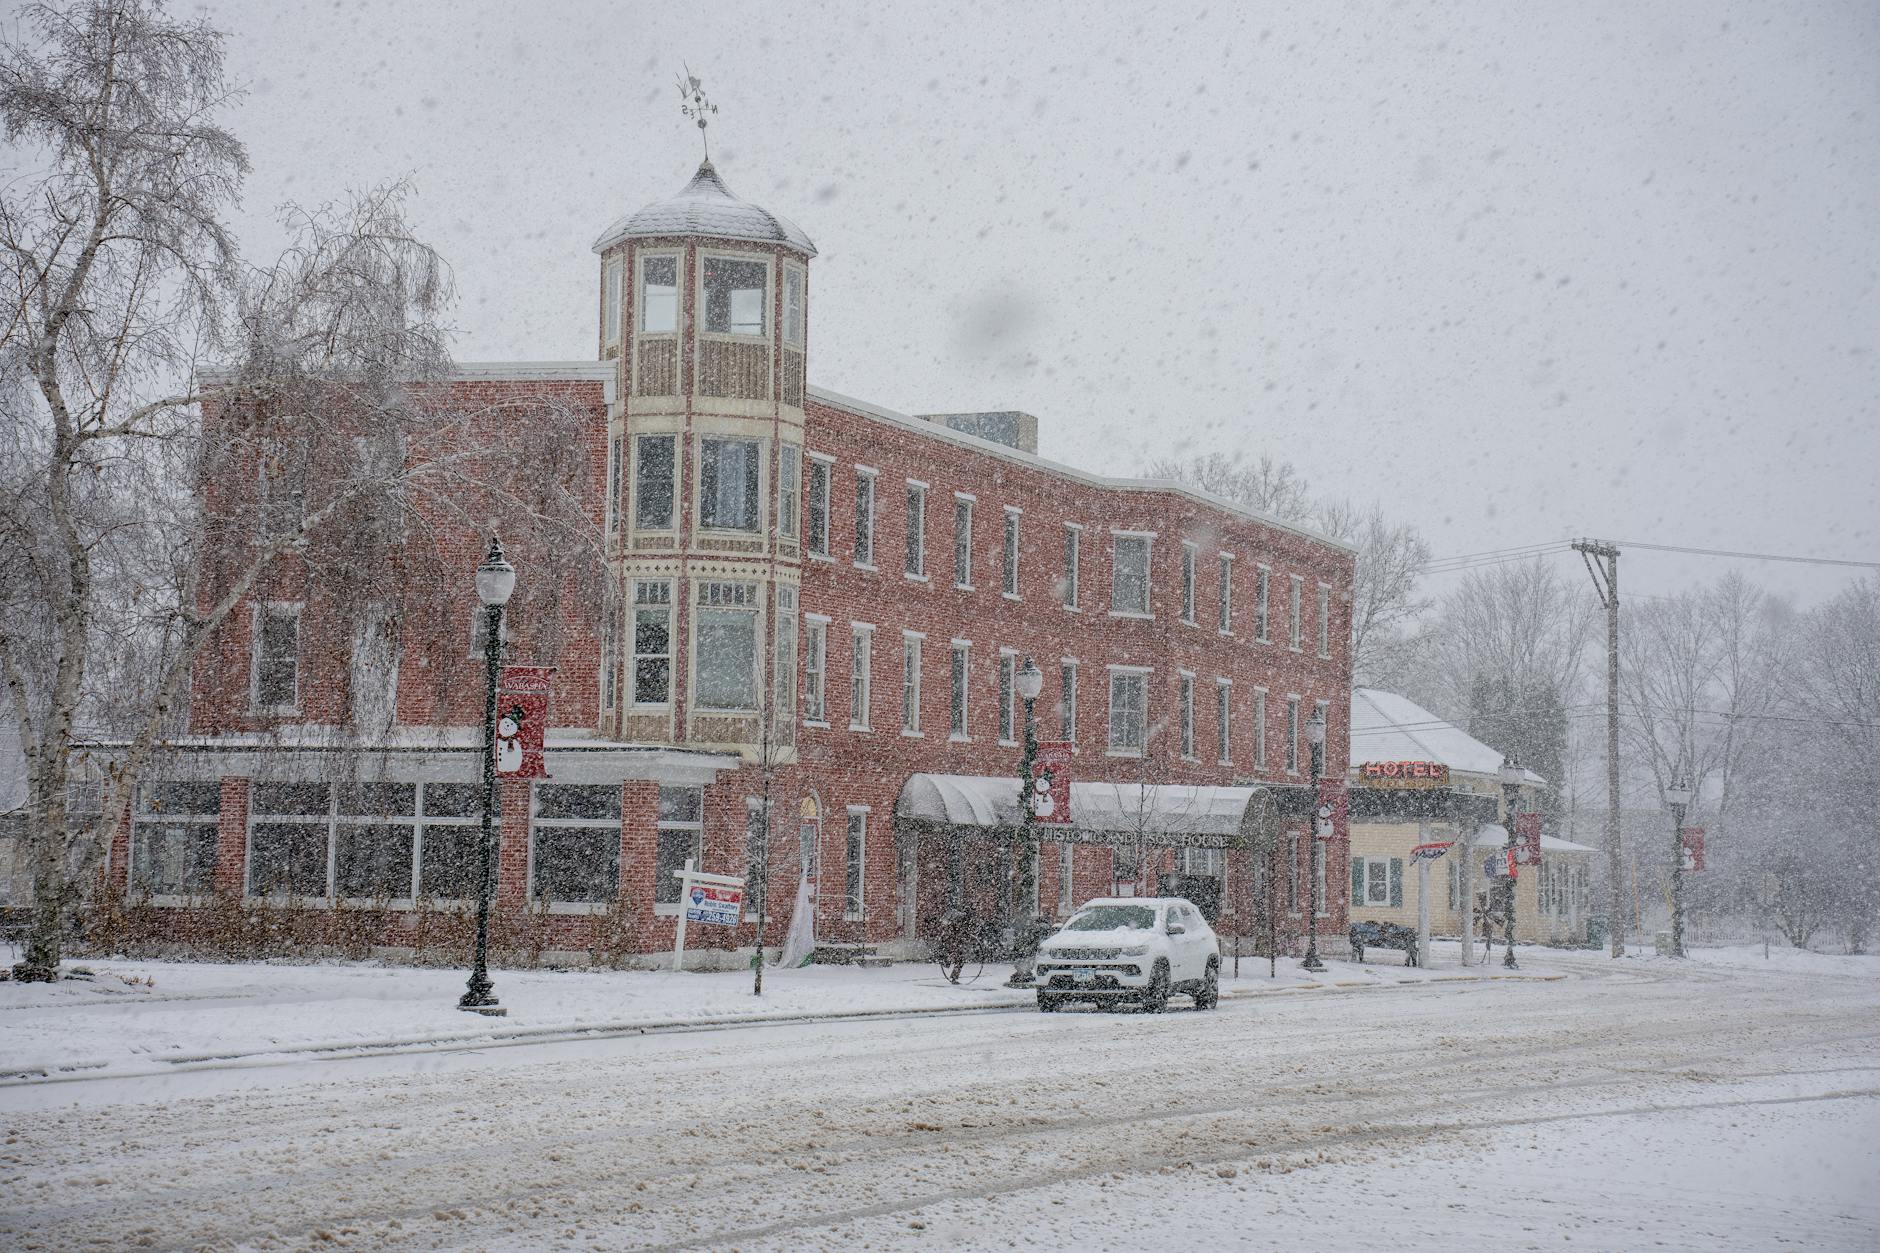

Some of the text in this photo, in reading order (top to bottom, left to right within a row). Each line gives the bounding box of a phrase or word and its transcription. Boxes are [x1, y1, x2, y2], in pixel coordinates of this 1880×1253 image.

[504, 682, 547, 690] WABASHA
[1365, 761, 1440, 779] HOTEL
[1182, 833, 1230, 849] HOUSE
[707, 912, 737, 925] 259-4926
